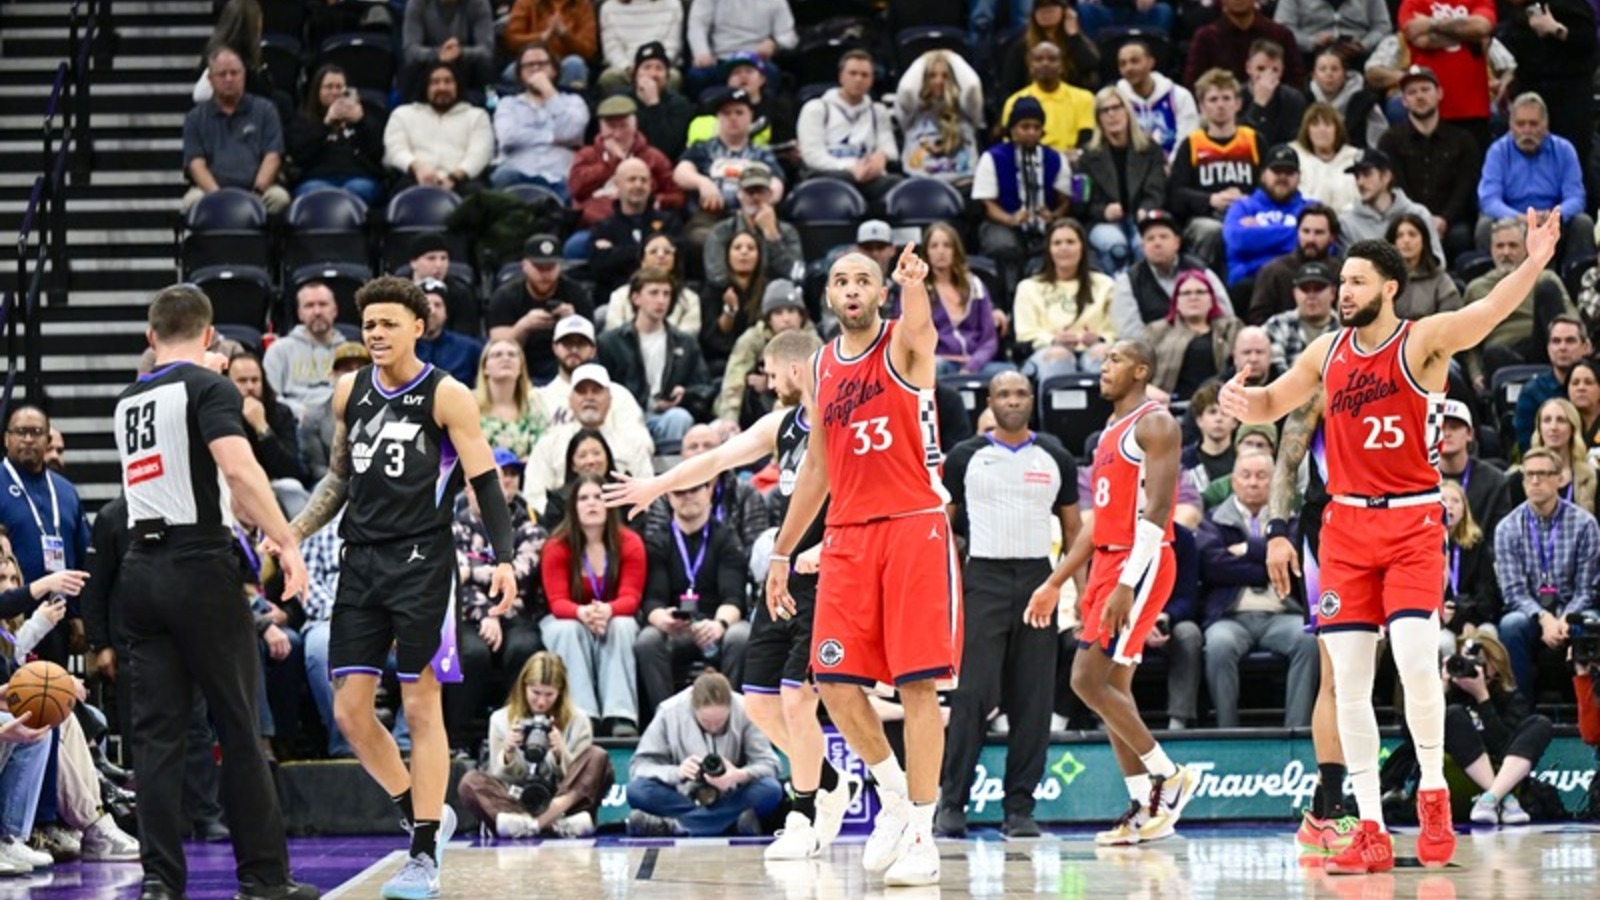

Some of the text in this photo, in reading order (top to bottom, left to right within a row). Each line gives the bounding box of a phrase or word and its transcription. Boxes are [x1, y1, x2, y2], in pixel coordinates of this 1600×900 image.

[1200, 161, 1252, 186] UTAH
[835, 378, 862, 403] Los
[1330, 379, 1400, 418] Angeles
[1345, 368, 1376, 393] Los
[823, 379, 884, 427] Angeles
[126, 400, 157, 455] 83
[850, 416, 893, 455] 33
[1362, 415, 1405, 449] 25
[384, 442, 405, 478] 3
[1095, 476, 1111, 508] 8
[1185, 760, 1356, 808] Travelp
